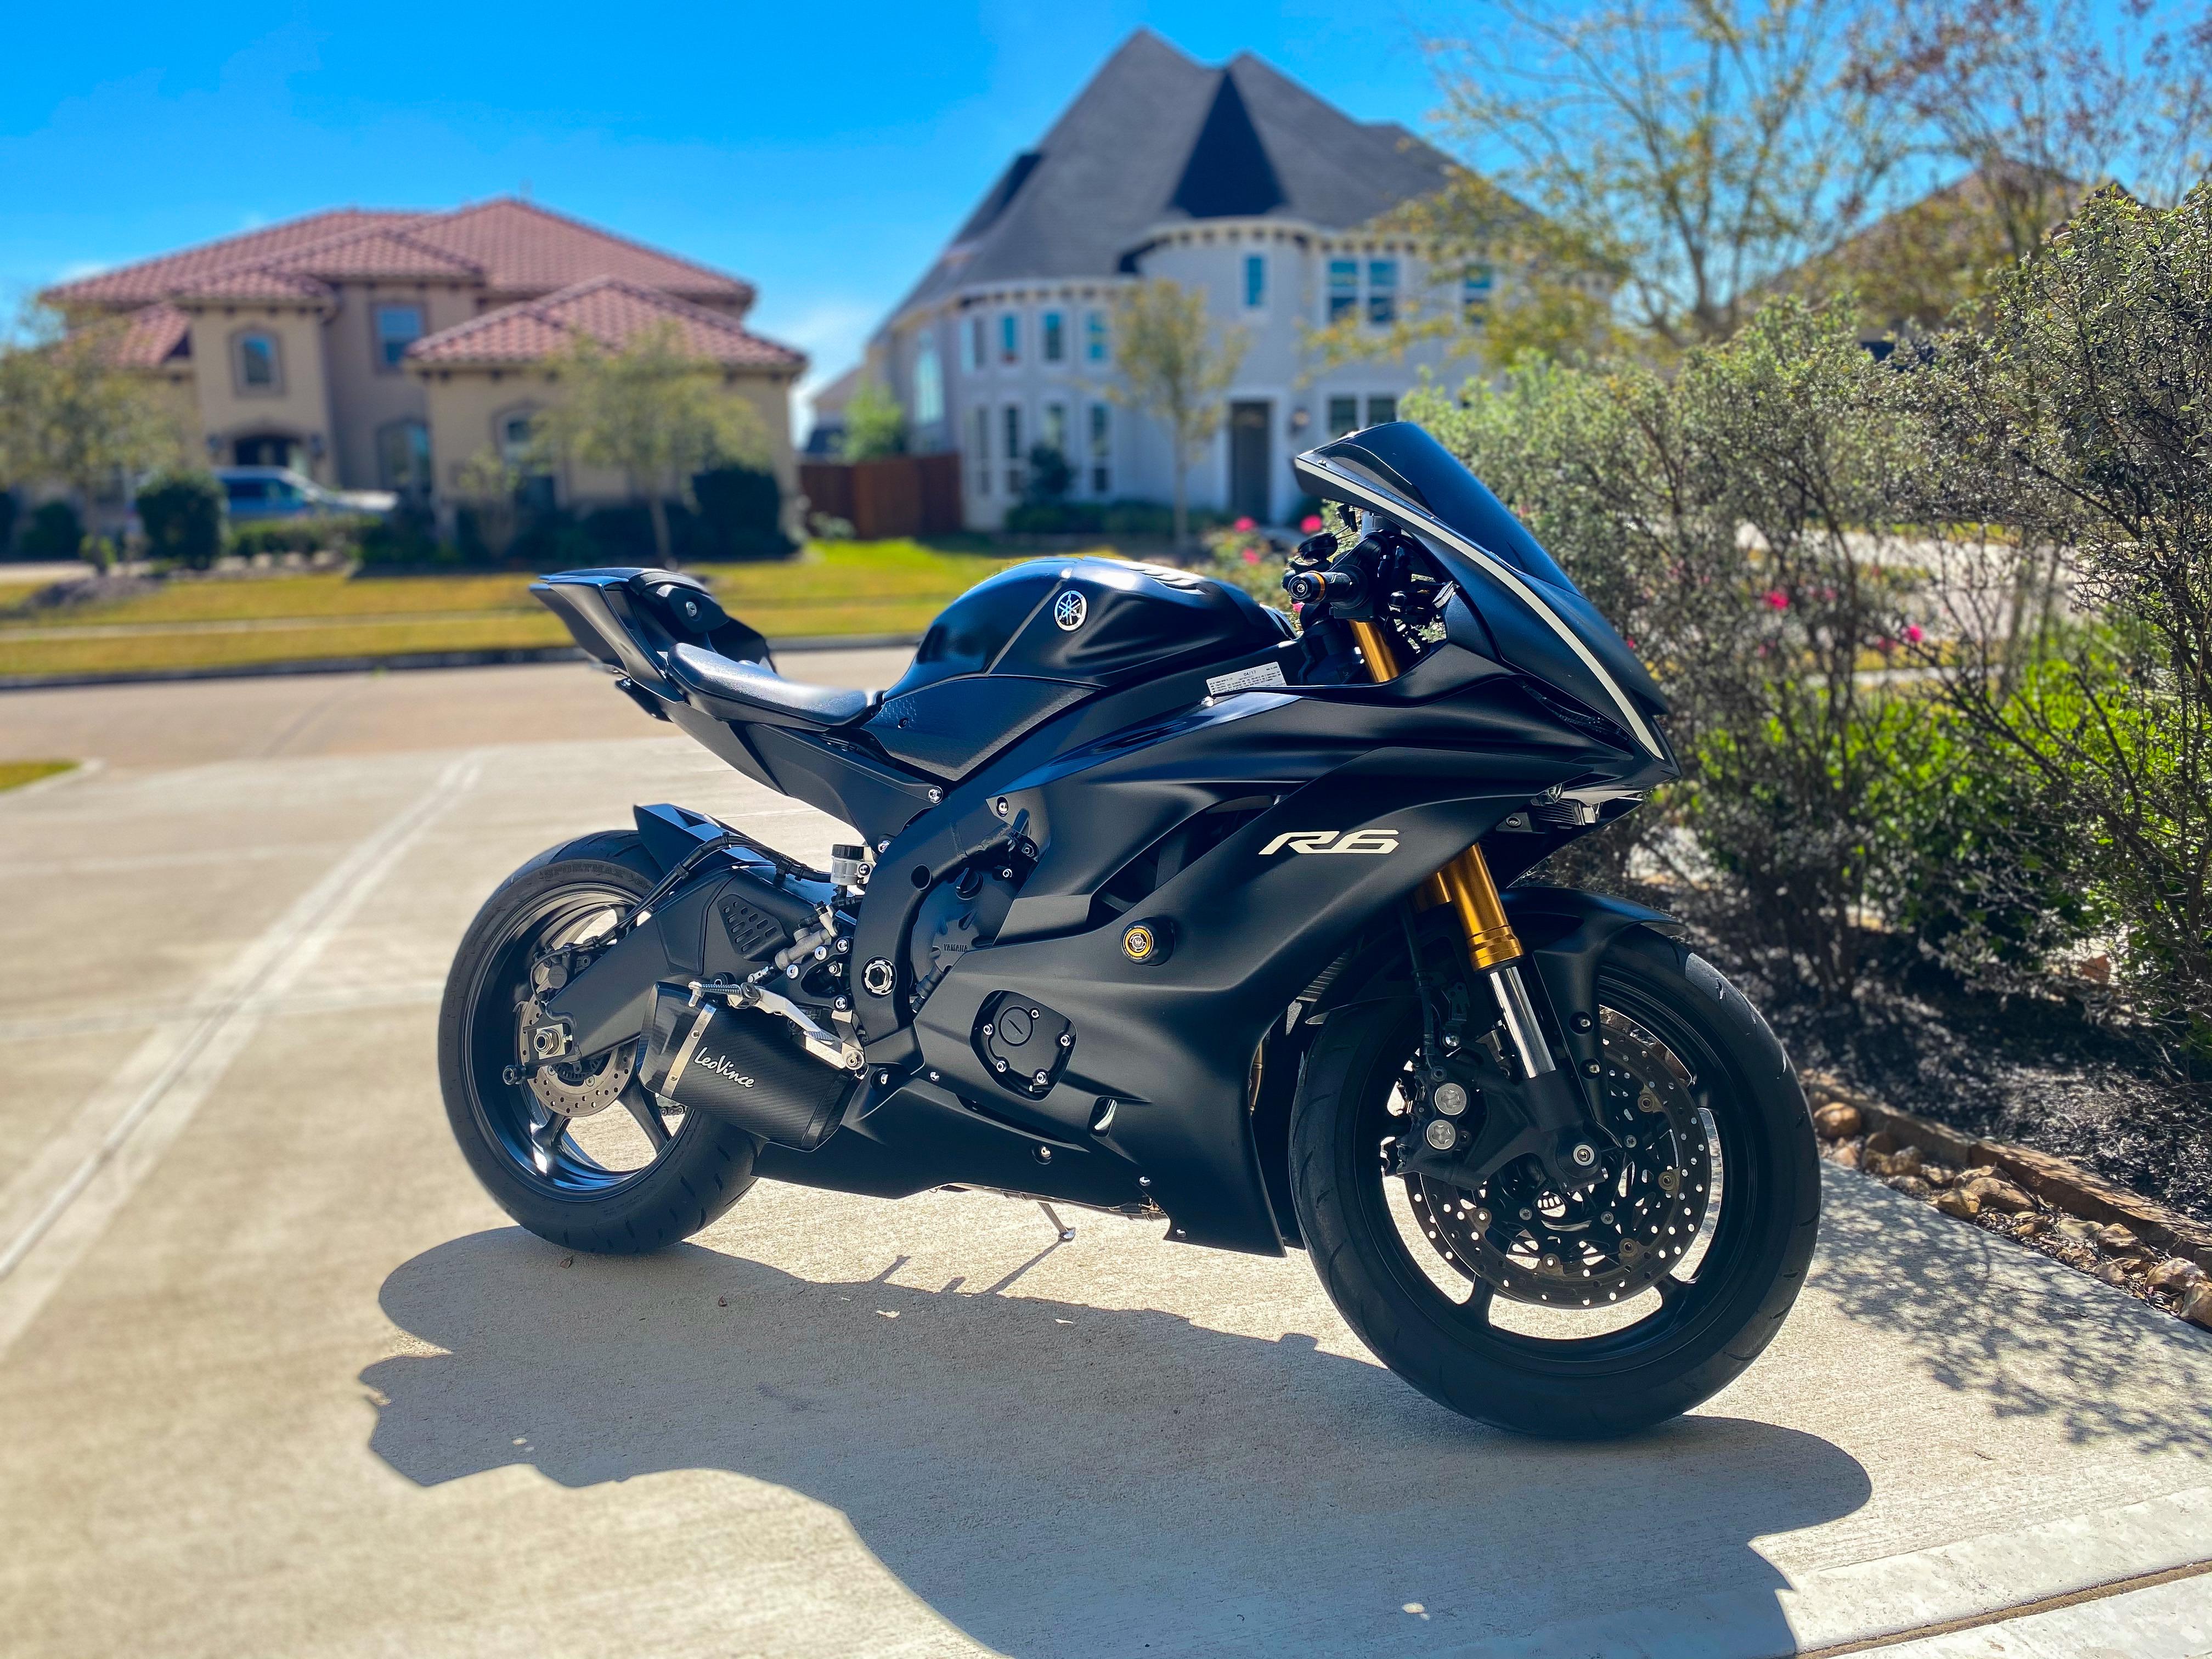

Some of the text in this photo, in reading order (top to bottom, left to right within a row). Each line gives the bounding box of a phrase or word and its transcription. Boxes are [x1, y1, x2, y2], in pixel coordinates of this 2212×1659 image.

[1258, 828, 1400, 855] R6
[944, 943, 968, 952] YAMAHA
[694, 1046, 754, 1088] LeoVince
